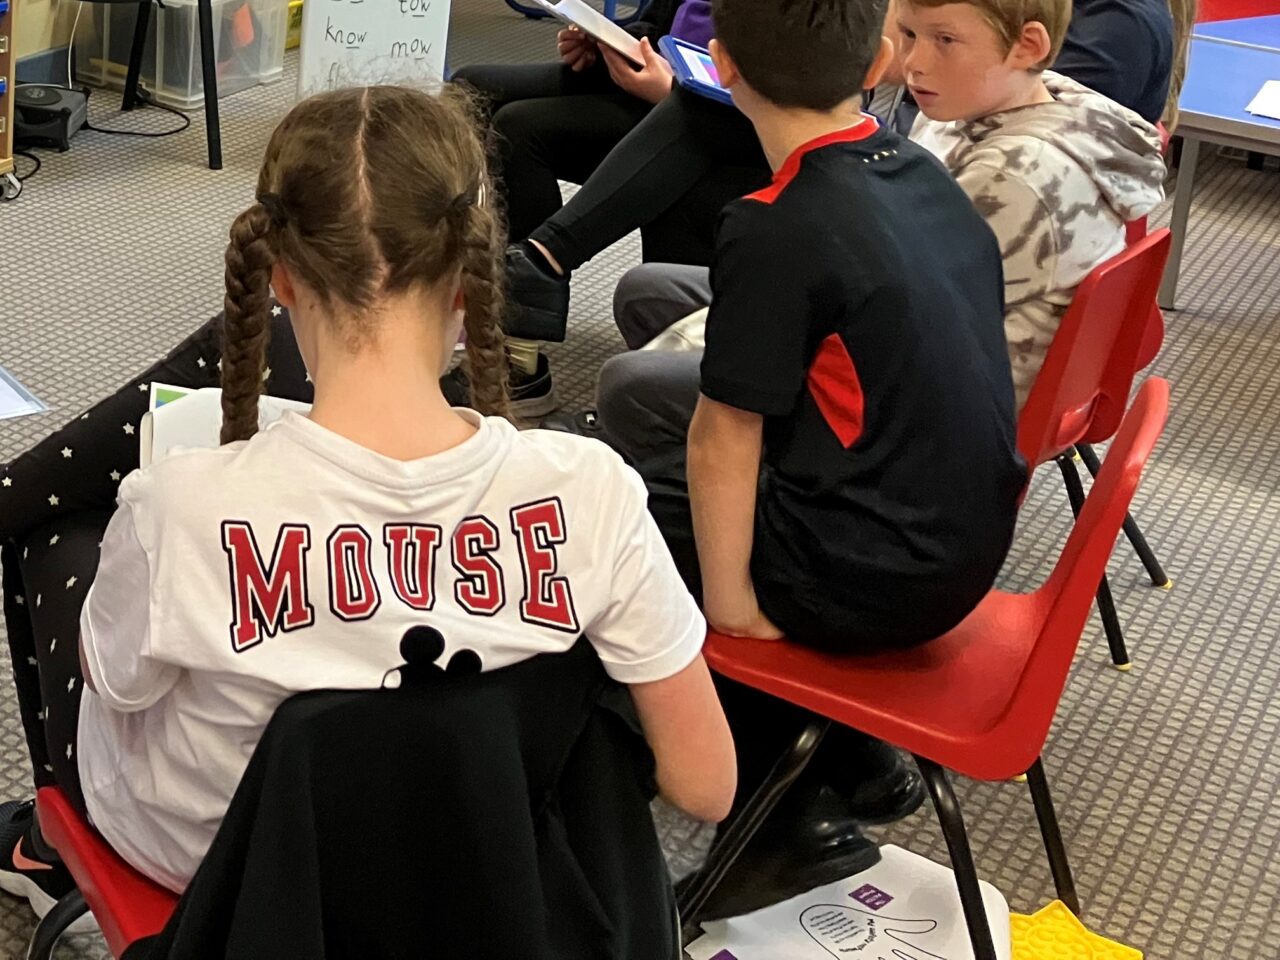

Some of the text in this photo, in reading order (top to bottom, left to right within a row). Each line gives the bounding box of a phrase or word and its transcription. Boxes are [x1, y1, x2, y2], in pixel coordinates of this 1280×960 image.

[325, 16, 367, 44] know
[391, 38, 432, 59] mow
[221, 496, 580, 653] MOUSE
